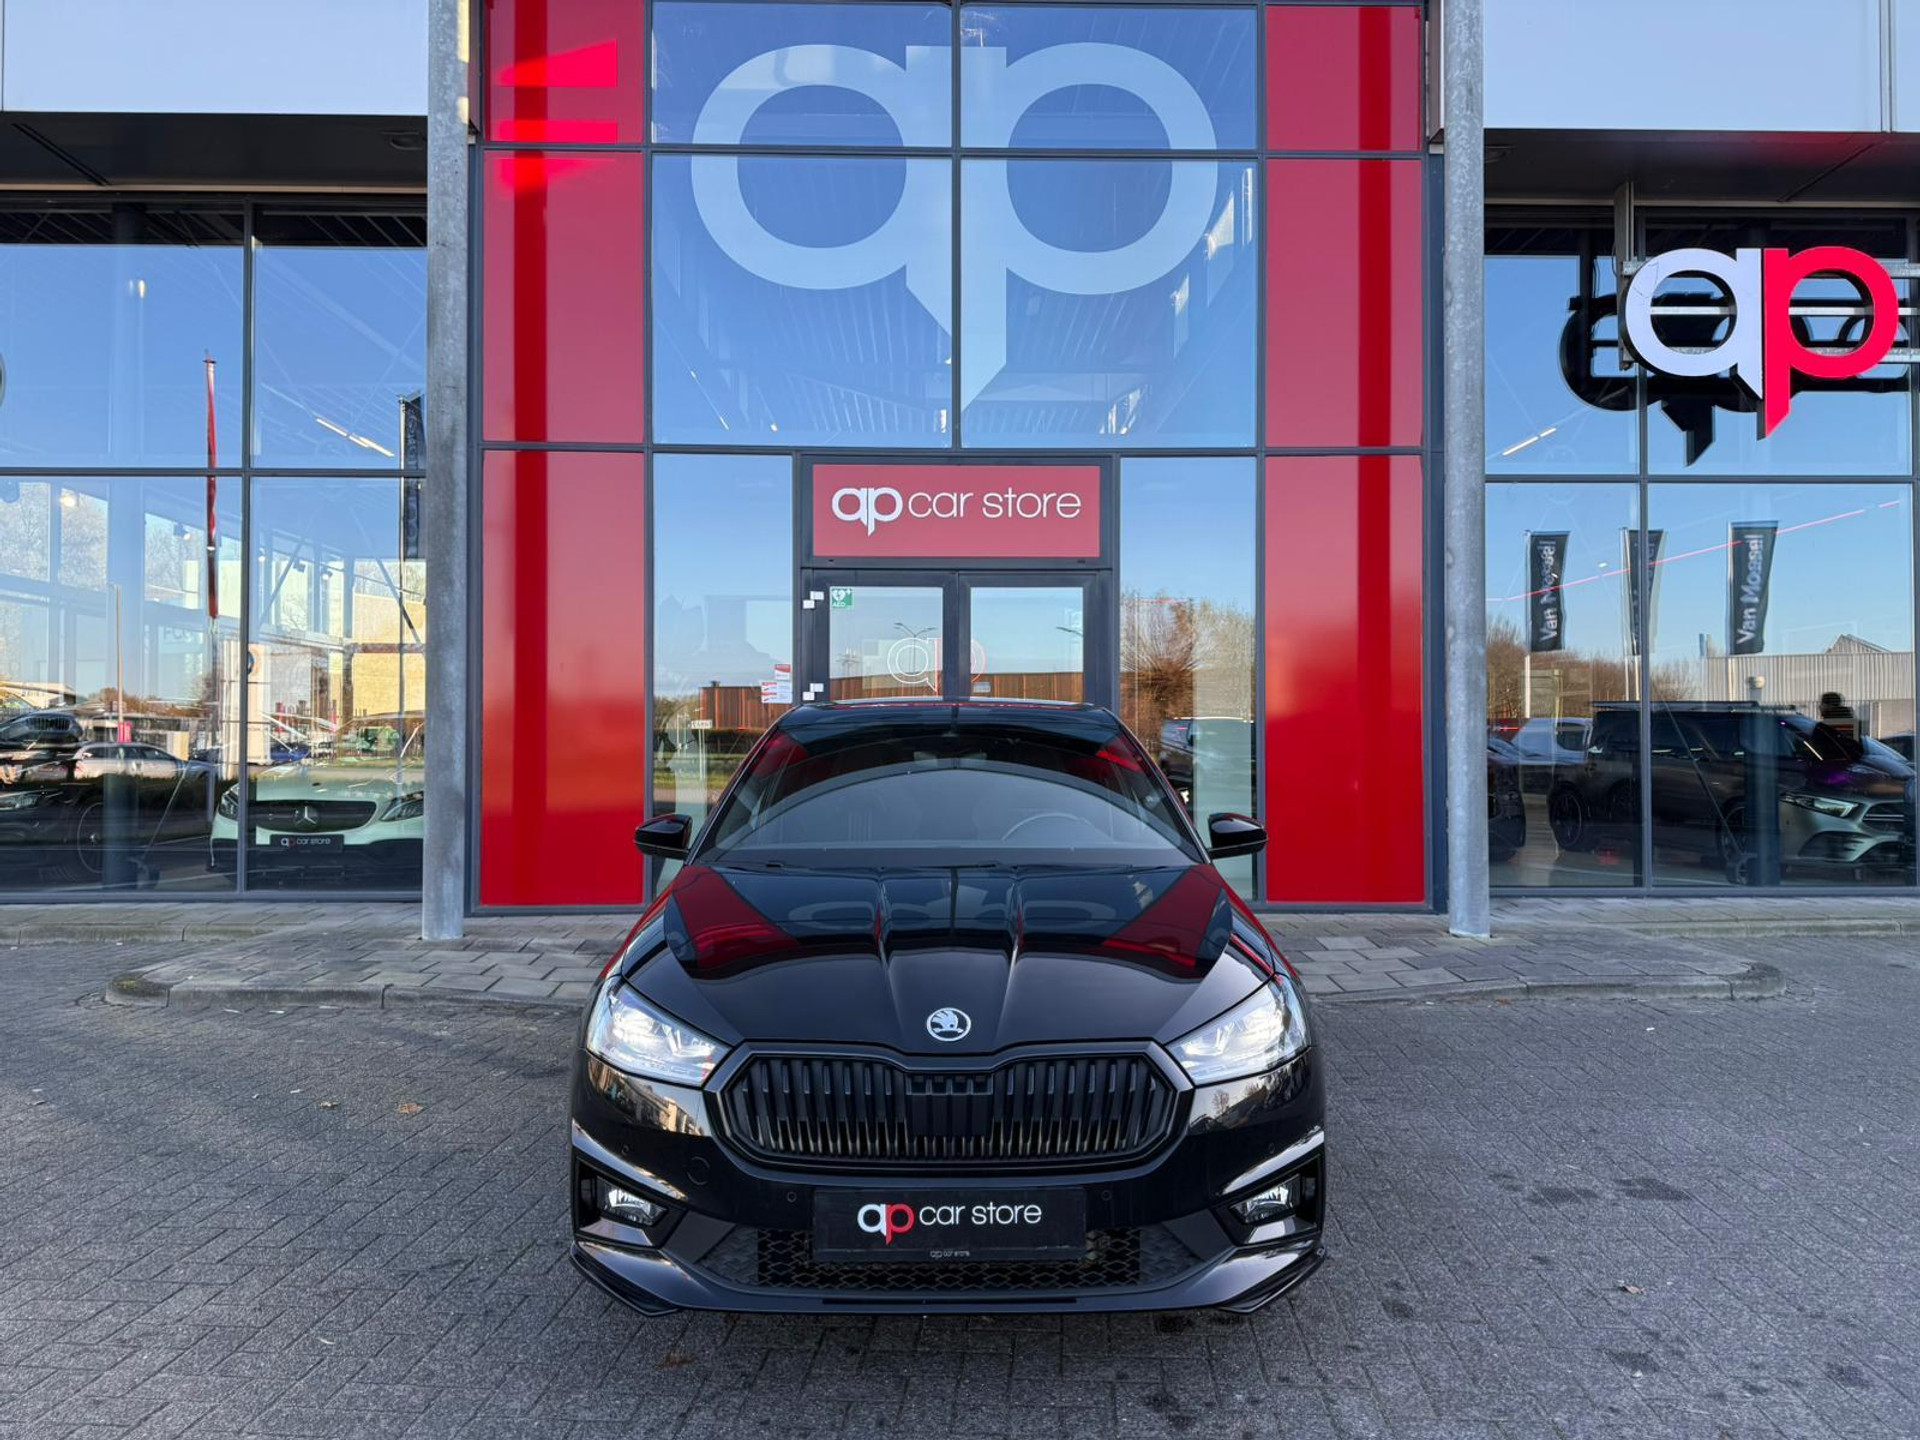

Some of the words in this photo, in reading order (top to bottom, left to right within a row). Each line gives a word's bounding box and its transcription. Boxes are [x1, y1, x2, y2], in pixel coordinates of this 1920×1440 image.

[690, 42, 1219, 414] ap
[1625, 245, 1899, 439] ap
[831, 486, 904, 537] ap
[908, 492, 974, 519] car
[982, 487, 1083, 519] store
[1740, 533, 1765, 604] Mossel
[1539, 607, 1558, 642] Van
[1736, 607, 1758, 645] Van
[857, 1203, 915, 1245] ap
[919, 1205, 966, 1226] car
[971, 1201, 1043, 1226] store
